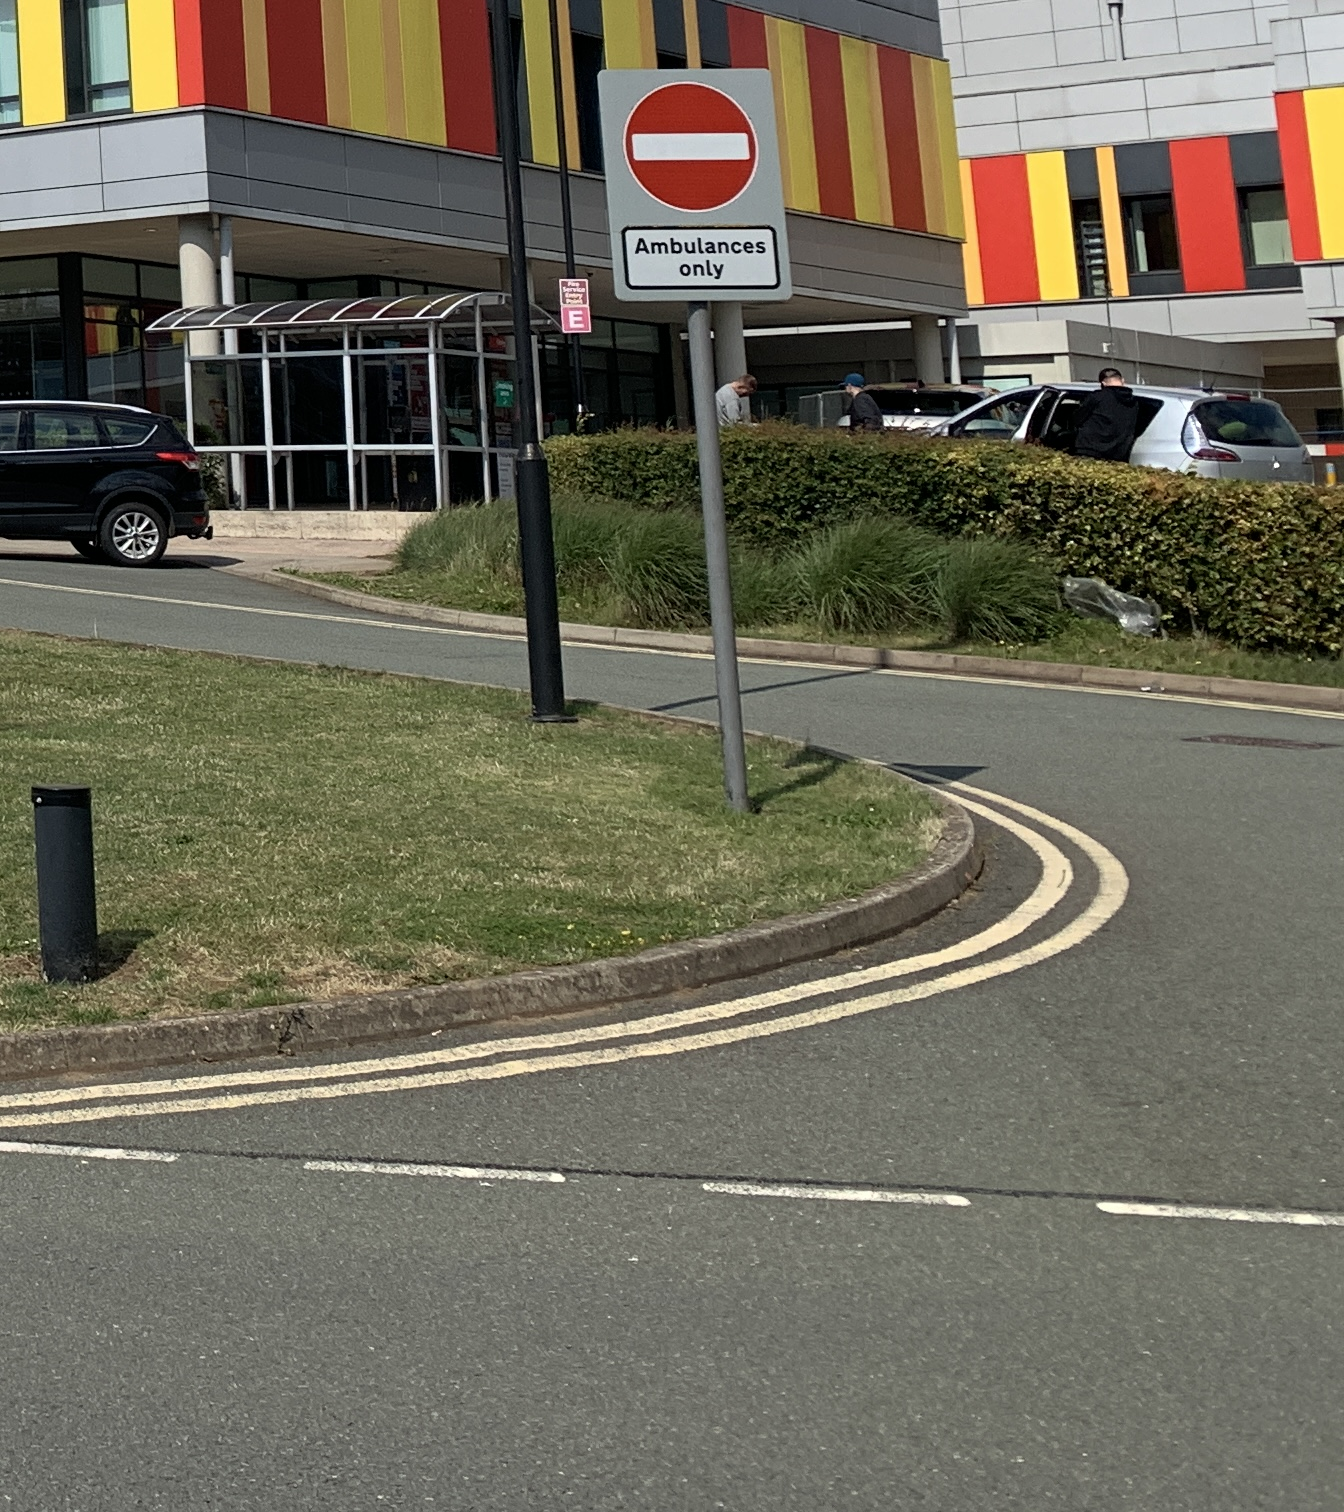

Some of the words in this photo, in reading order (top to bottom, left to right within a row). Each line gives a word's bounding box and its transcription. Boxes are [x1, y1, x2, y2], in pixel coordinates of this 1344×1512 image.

[634, 237, 767, 255] Ambulances
[679, 259, 725, 280] only
[568, 310, 585, 329] E
